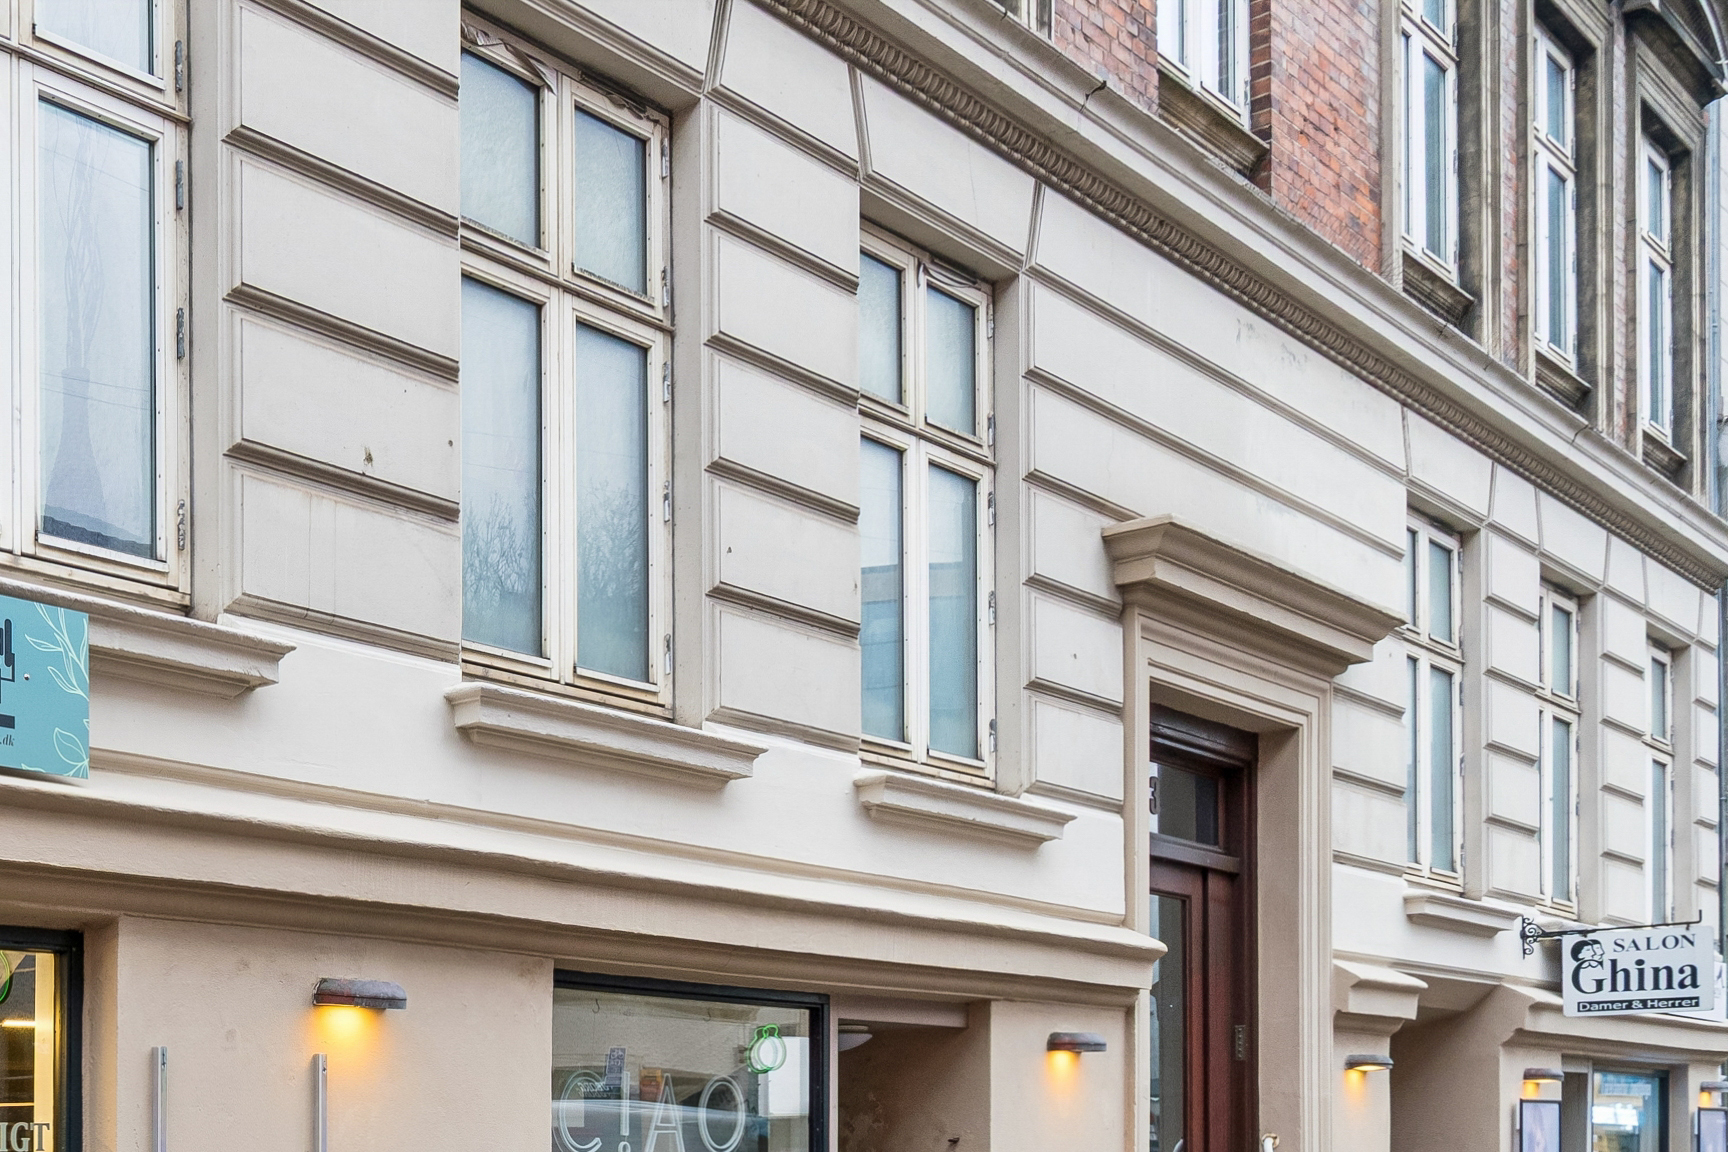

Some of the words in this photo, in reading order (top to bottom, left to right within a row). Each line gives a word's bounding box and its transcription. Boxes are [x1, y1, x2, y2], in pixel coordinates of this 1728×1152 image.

[1613, 934, 1696, 953] SALON
[1571, 958, 1701, 994] Ghina
[1579, 1001, 1628, 1011] Damer
[1632, 1000, 1643, 1009] &
[1647, 998, 1698, 1008] Herrer
